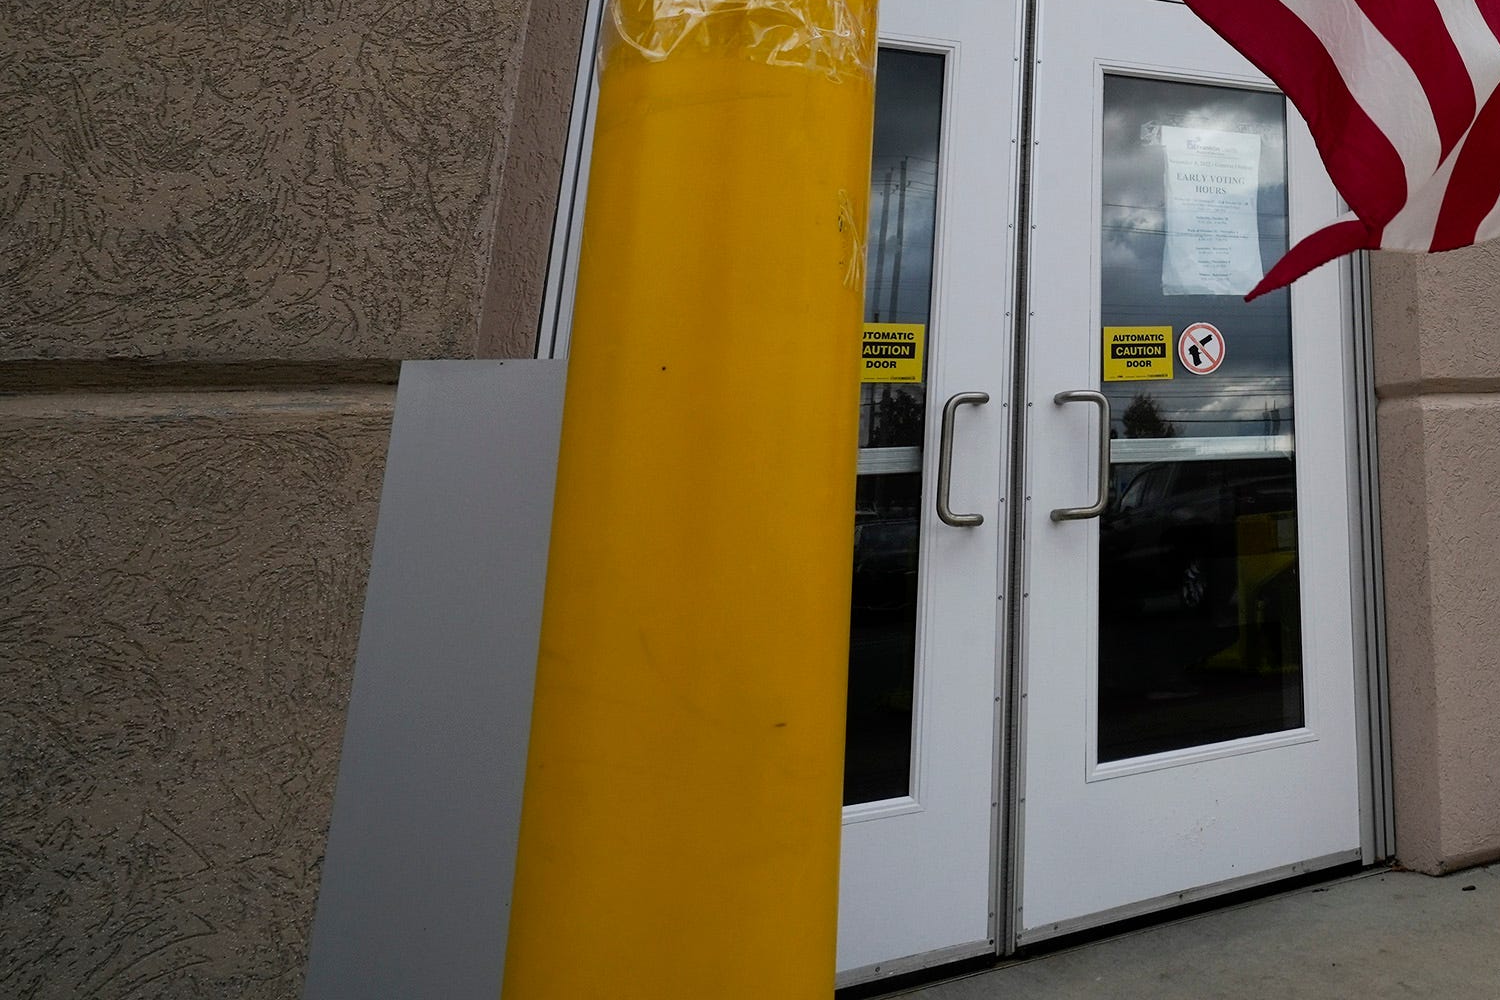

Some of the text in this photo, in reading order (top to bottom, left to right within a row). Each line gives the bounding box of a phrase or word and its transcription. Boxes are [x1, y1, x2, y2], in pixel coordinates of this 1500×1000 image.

[1176, 172, 1245, 185] EARLY VOTING
[1195, 185, 1226, 195] HOURS
[862, 331, 914, 340] UTOMATIC
[1113, 334, 1164, 342] AUTOMATIC
[863, 345, 910, 355] AUTION
[1116, 346, 1161, 356] CAUTION
[866, 360, 897, 368] DOOR
[1127, 360, 1152, 368] DOOR
